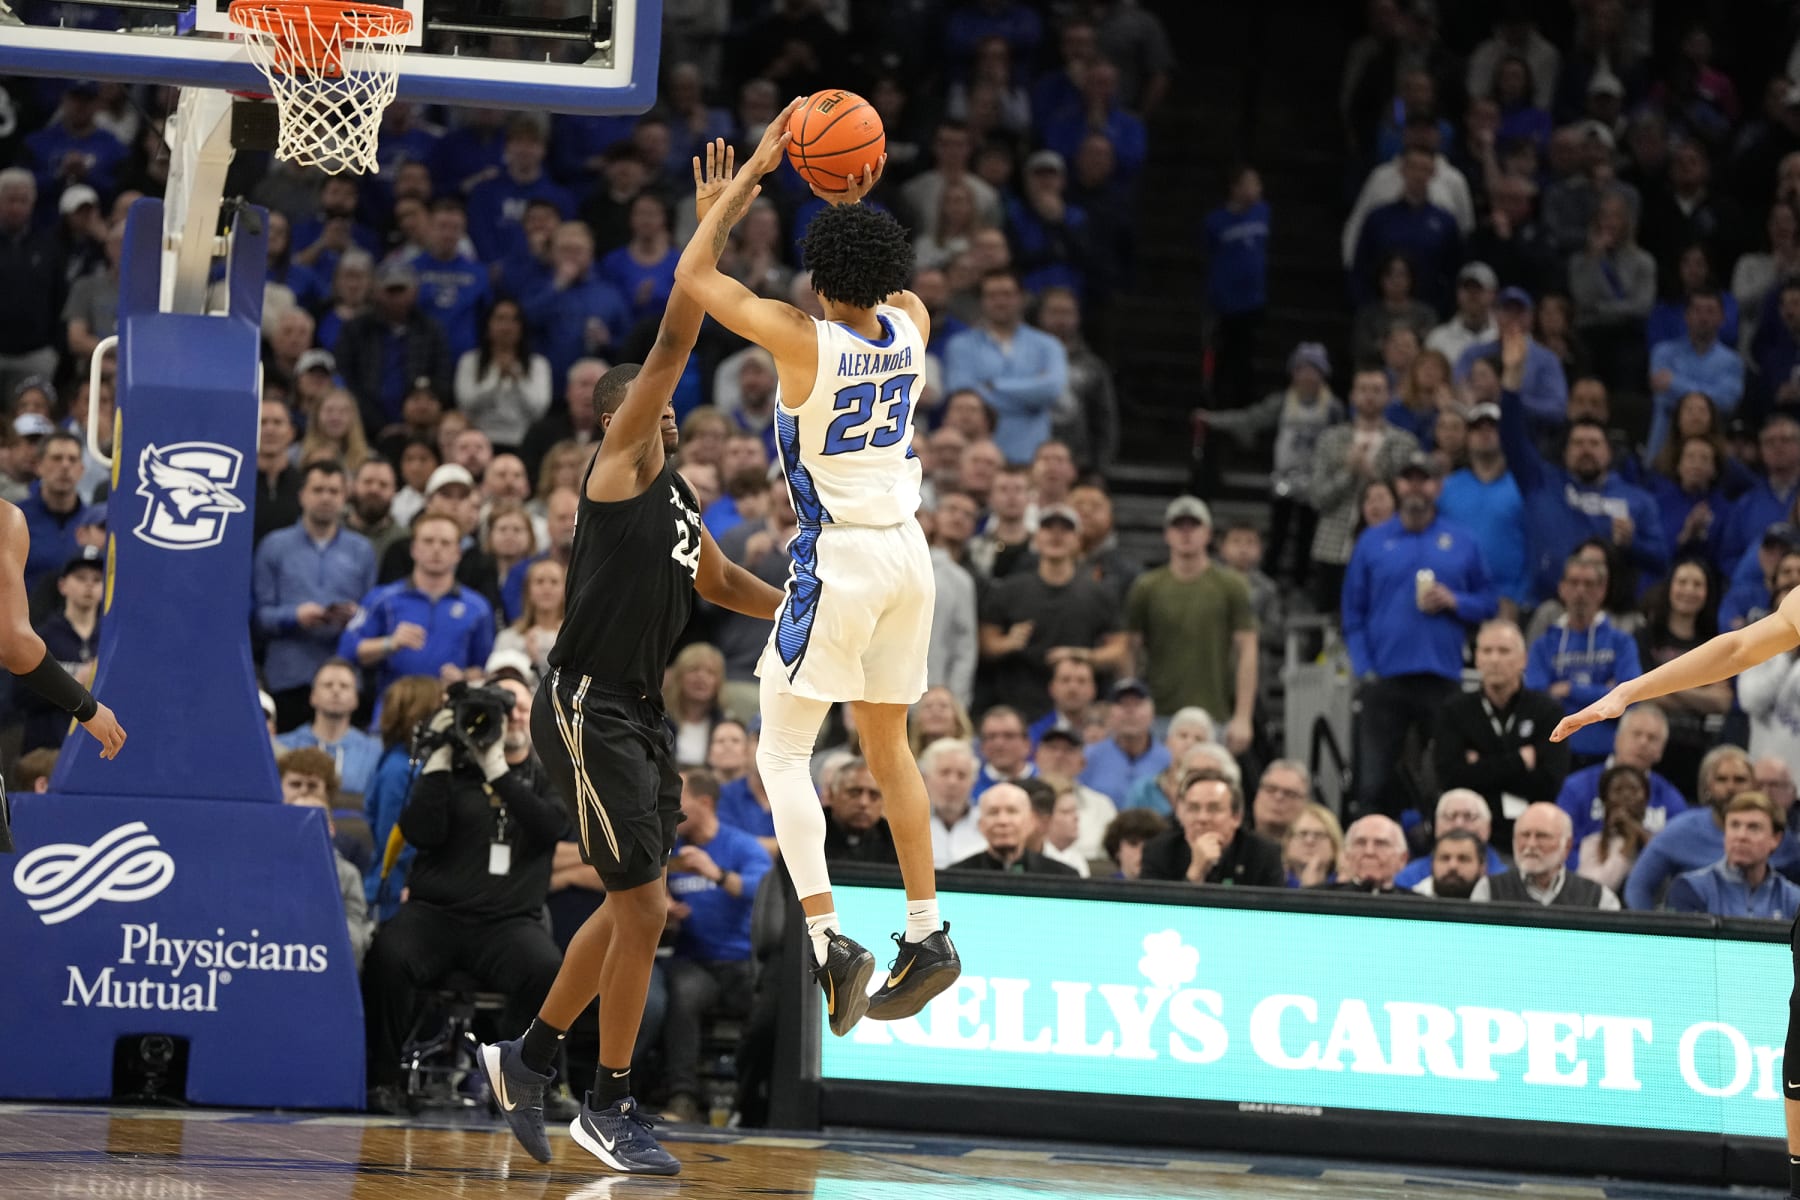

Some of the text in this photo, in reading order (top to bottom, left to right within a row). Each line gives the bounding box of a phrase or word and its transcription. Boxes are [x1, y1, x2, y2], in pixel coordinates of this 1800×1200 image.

[837, 346, 912, 376] ALEXANDER
[819, 373, 919, 456] 23
[118, 922, 328, 977] Physicians
[1249, 993, 1653, 1091] CARPET
